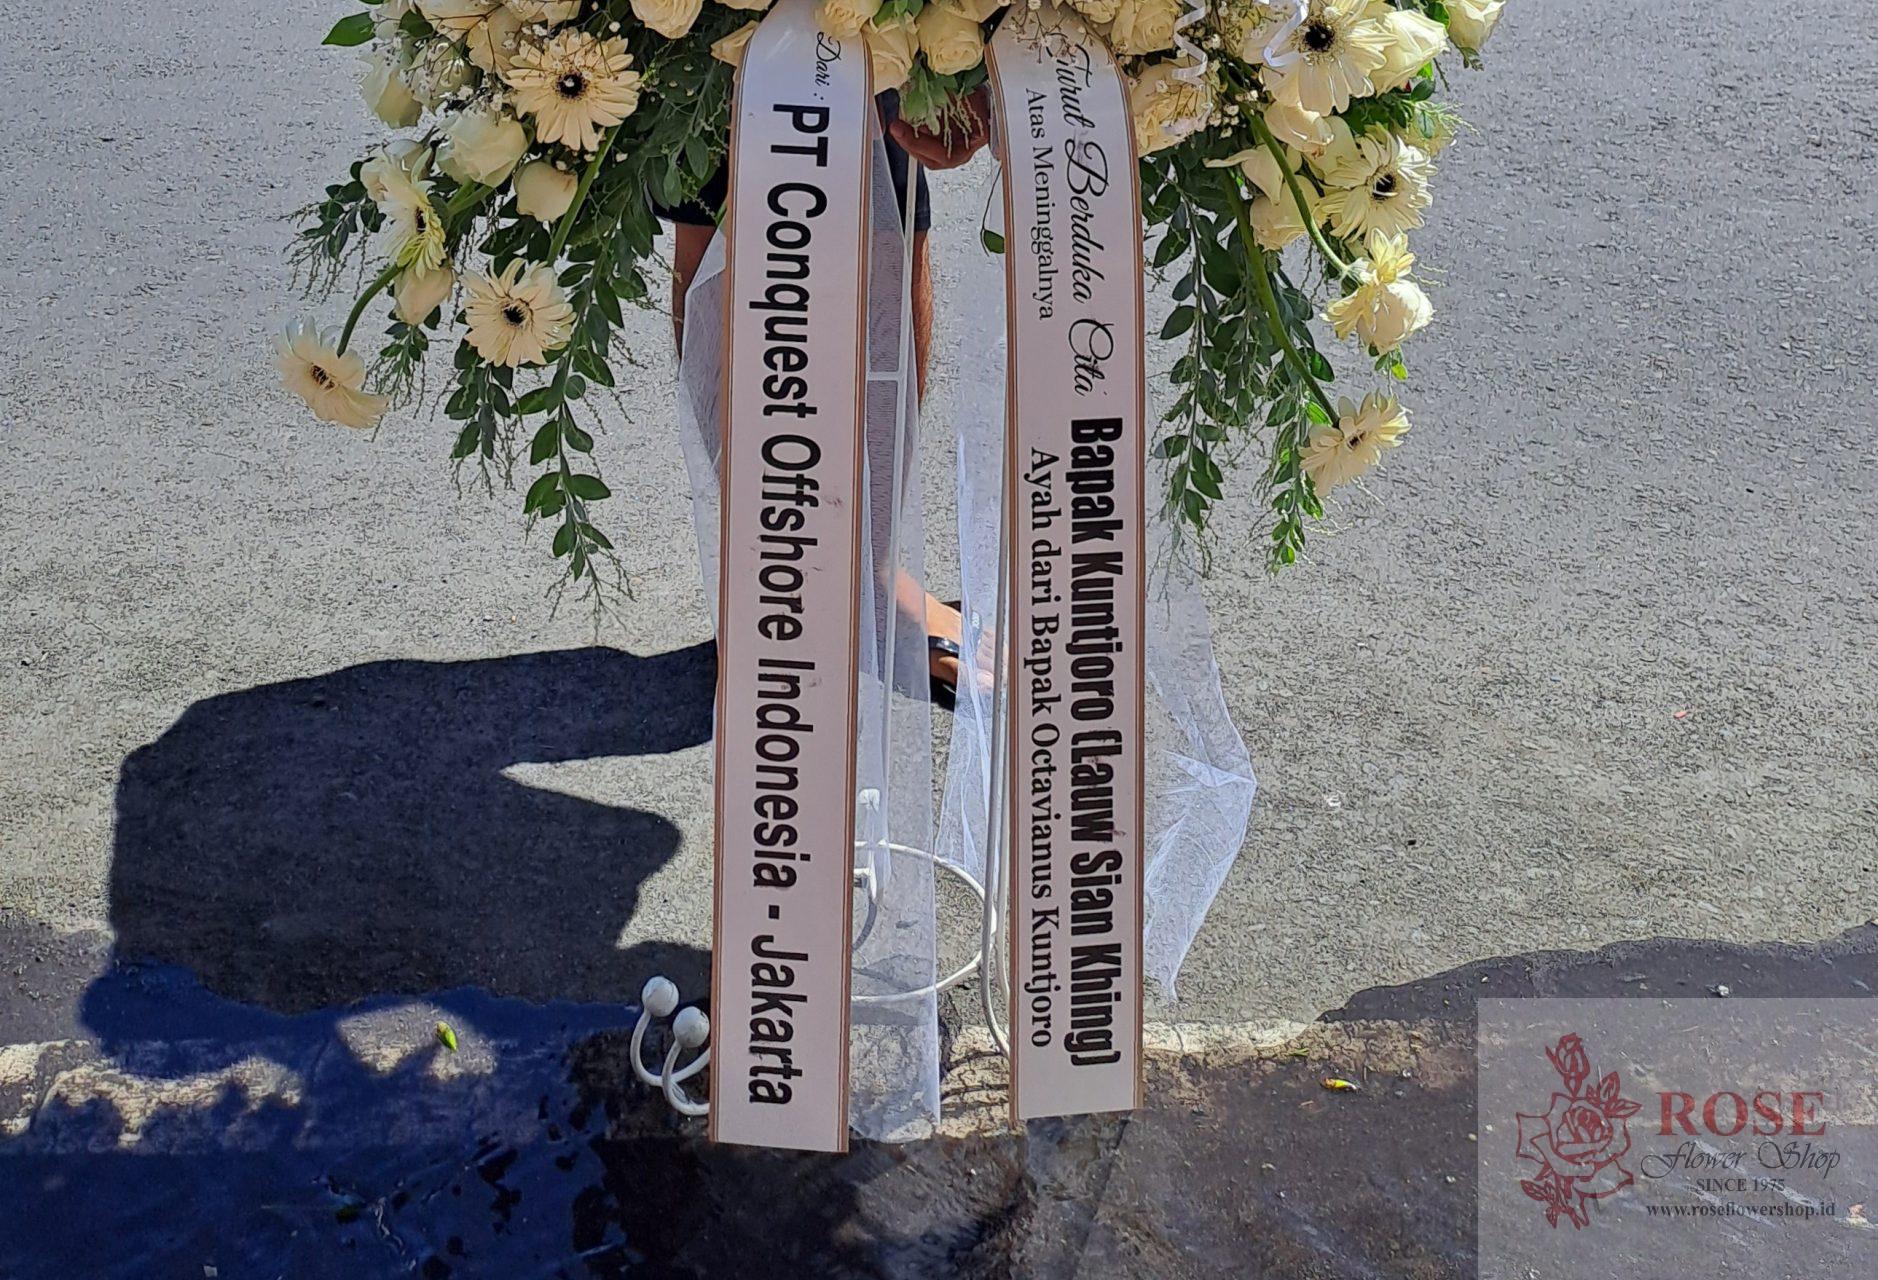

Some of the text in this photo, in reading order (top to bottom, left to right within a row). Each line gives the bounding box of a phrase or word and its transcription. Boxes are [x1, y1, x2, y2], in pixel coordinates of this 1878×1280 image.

[770, 103, 830, 168] PT
[815, 31, 842, 87] Dari
[749, 182, 828, 419] Conquest
[1026, 88, 1059, 321] Atas Meninggalnya
[1064, 136, 1110, 305] Berduka
[1068, 318, 1115, 397] Cita
[757, 434, 822, 641] Offshore
[753, 658, 816, 889] Indonesia
[1023, 446, 1062, 1049] Ayah dari Bapak Octavianus Kuntjoro
[1064, 417, 1124, 1067] Bapak Kuntjoro (Lauw Sian Khing)
[747, 934, 809, 1105] Jakarta
